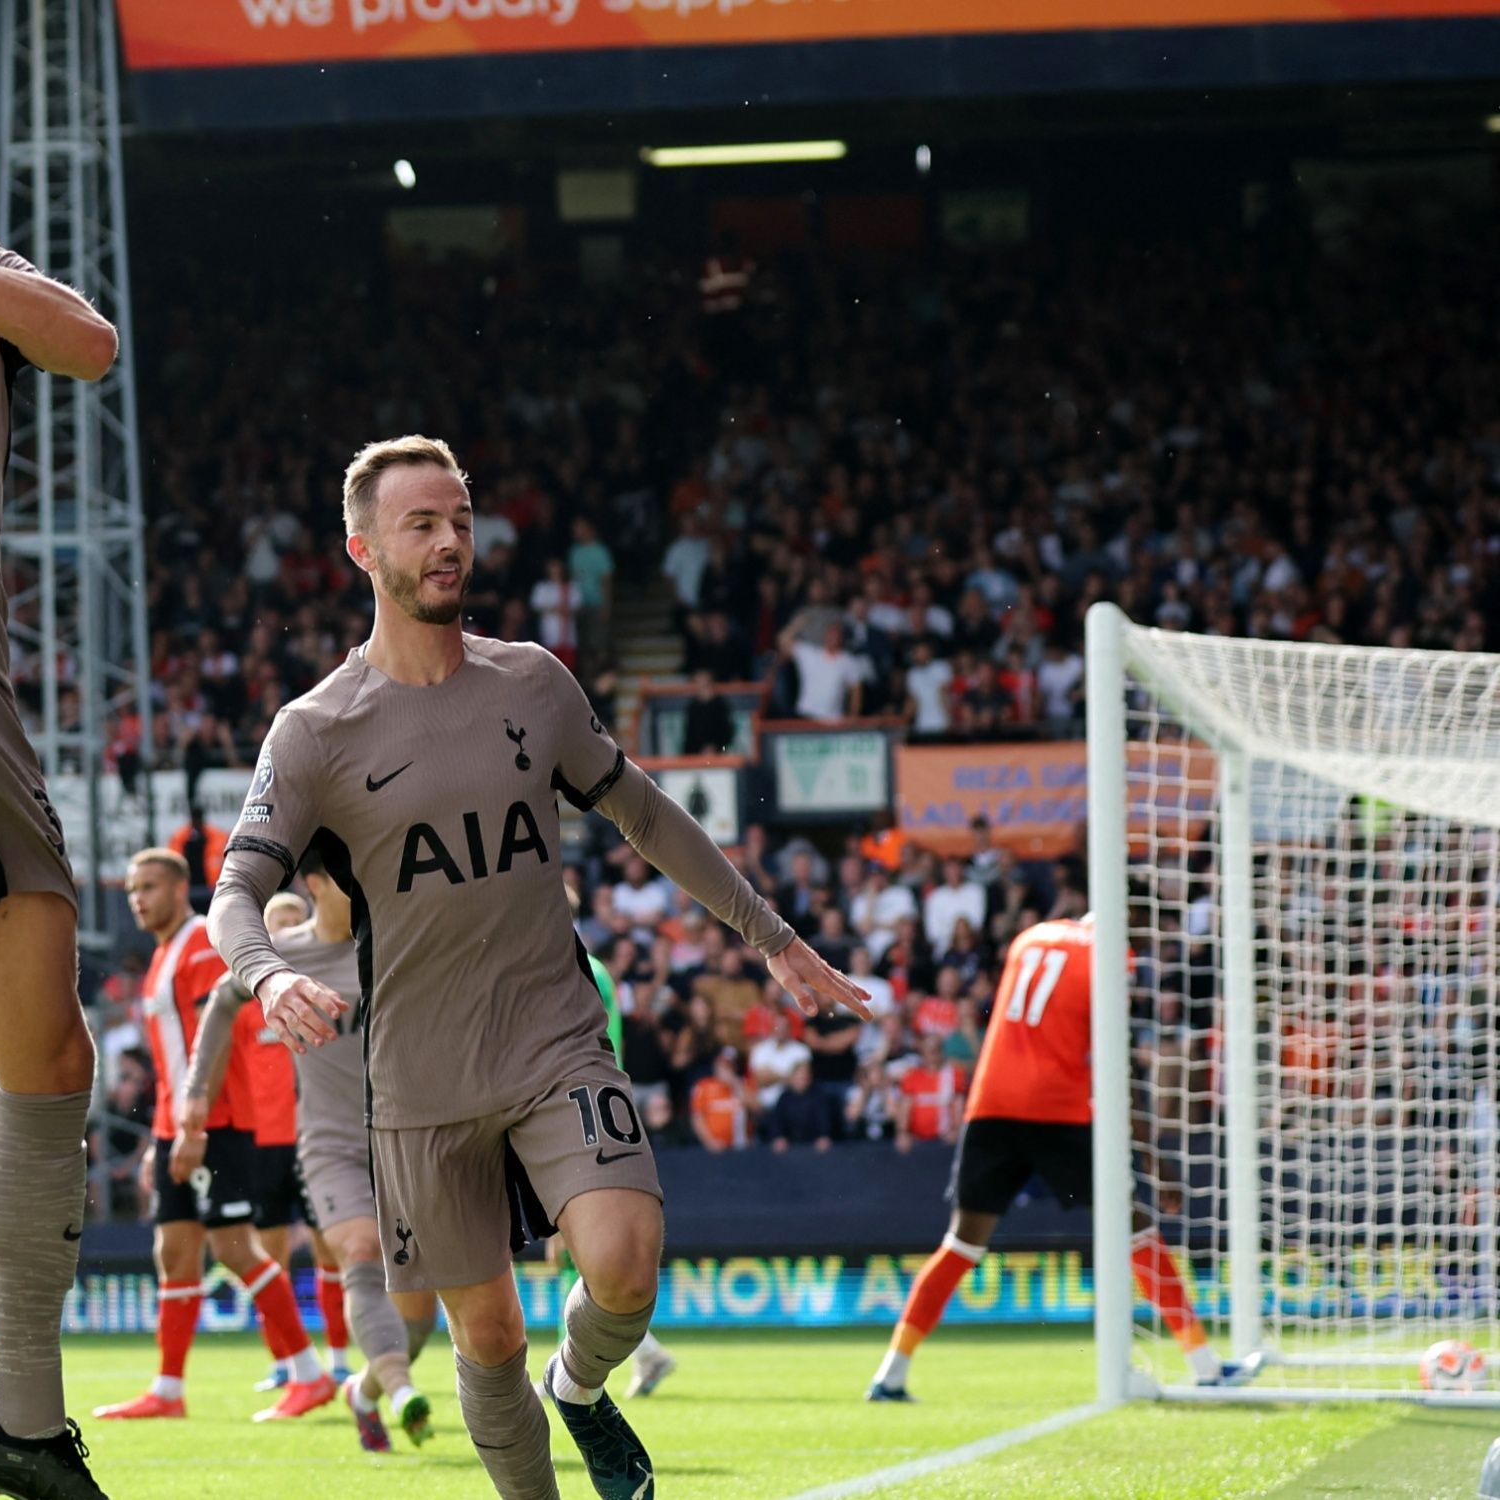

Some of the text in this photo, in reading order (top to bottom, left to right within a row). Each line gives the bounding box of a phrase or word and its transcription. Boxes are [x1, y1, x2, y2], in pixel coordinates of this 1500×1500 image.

[396, 801, 550, 893] AIA
[1007, 946, 1068, 1027] 11
[567, 1085, 642, 1147] 10
[671, 1257, 842, 1314] NOW
